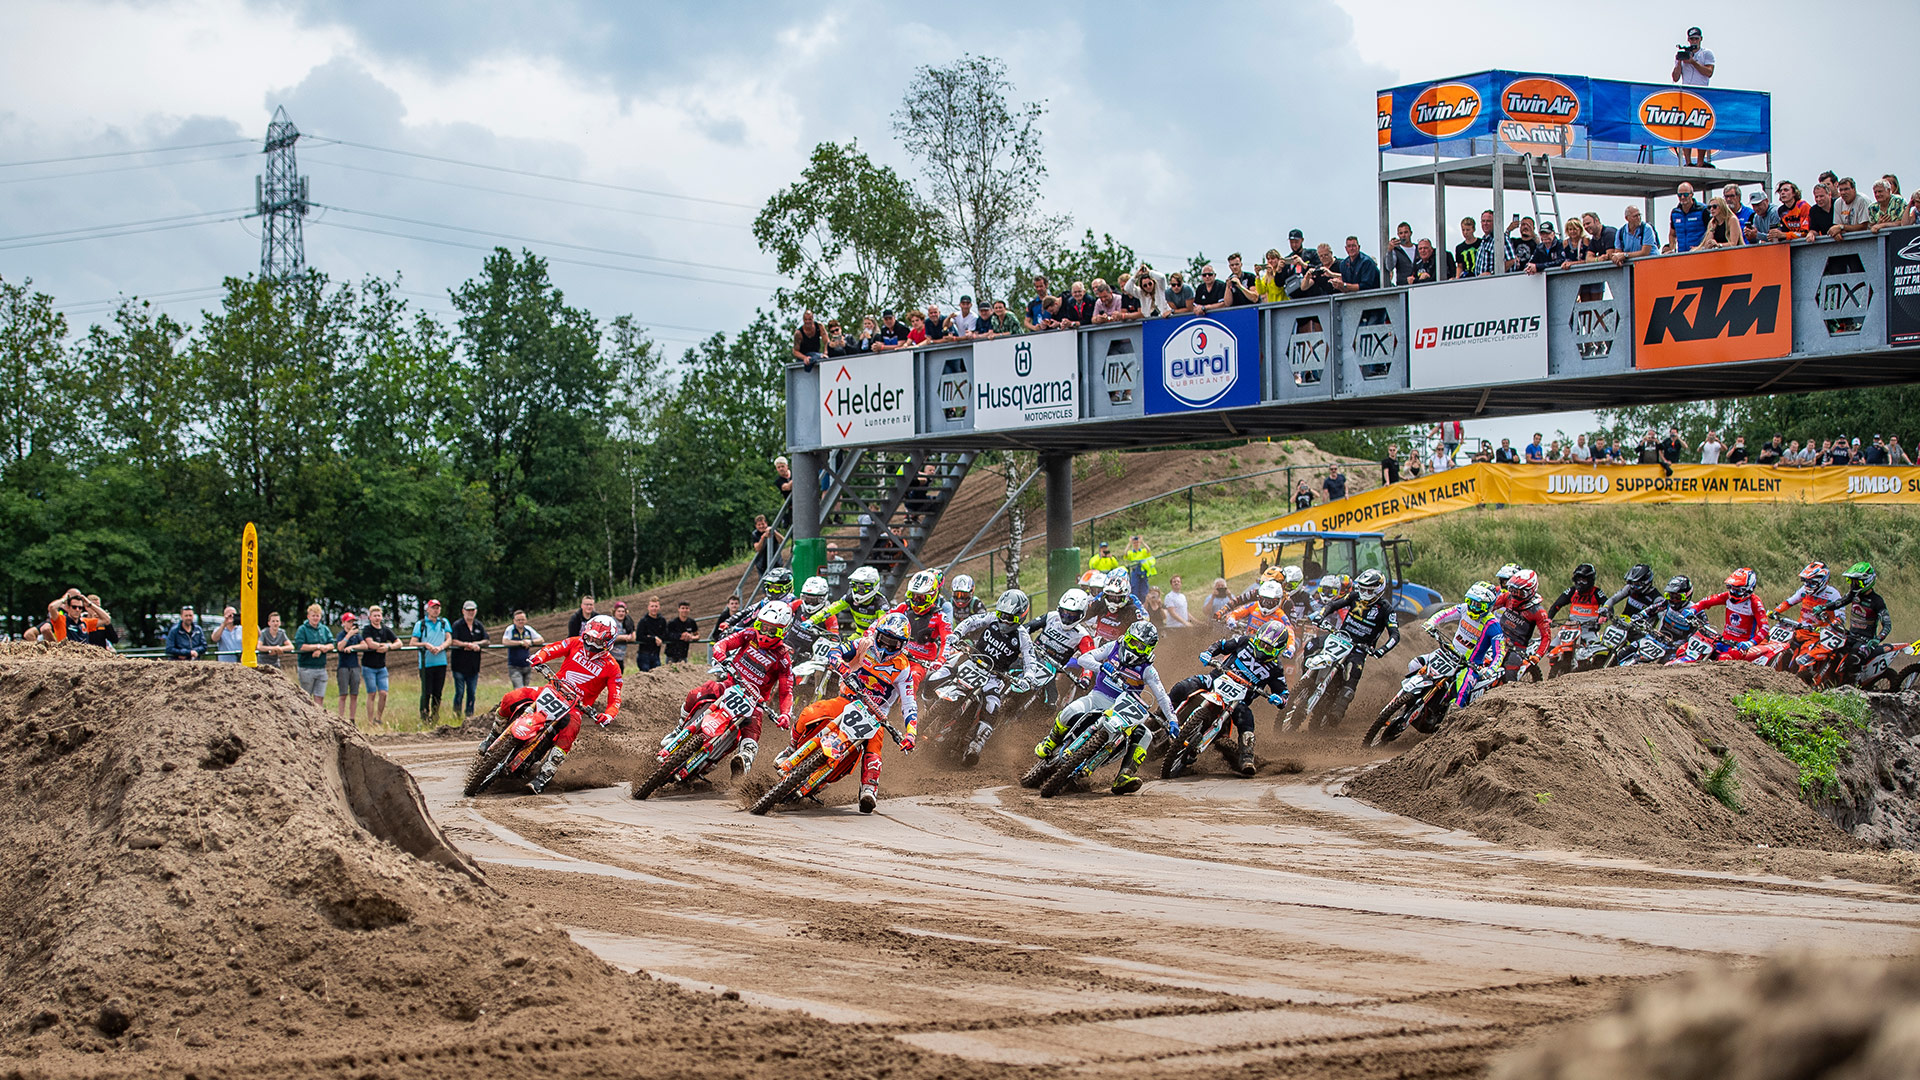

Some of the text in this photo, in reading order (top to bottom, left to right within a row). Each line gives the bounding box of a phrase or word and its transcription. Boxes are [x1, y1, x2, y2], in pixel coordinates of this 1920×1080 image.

[1416, 97, 1478, 123] Twin Air
[1508, 93, 1576, 114] Twin Air
[1646, 106, 1711, 127] Twin Air
[1894, 275, 1911, 286] BUTT
[1643, 273, 1781, 345] KTM
[1442, 315, 1541, 341] HOCOPARTS
[1440, 332, 1539, 347] PREMIUM MOTORCYCLE PRODUCTS
[1171, 347, 1229, 379] eurol
[1170, 376, 1231, 388] LUBRICANTS
[838, 383, 904, 416] Helder
[977, 380, 1072, 411] Husqvarna
[865, 415, 911, 427] Lunteren BV
[1024, 409, 1073, 422] MOTORCYCLES
[1546, 475, 1782, 495] JUMBO SUPPORTER VAN TALENT
[1847, 476, 1902, 494] JUMBO
[1321, 498, 1398, 532] SUPPORTER
[1402, 492, 1427, 510] VAN
[1429, 478, 1476, 503] TALENT
[983, 629, 1014, 657] Quality
[1560, 630, 1578, 641] 181
[1604, 629, 1625, 647] 52
[1769, 627, 1790, 642] 199
[1820, 630, 1843, 648] 73
[746, 645, 772, 667] THOR
[984, 644, 1002, 660] MX
[1325, 640, 1348, 657] 27
[1640, 641, 1663, 658] 228
[1688, 639, 1708, 654] 94
[734, 662, 764, 685] GASGAS
[1237, 648, 1270, 680] FXR
[1429, 654, 1453, 675] 130
[1872, 659, 1888, 674] 73
[958, 665, 987, 688] 826
[1217, 681, 1241, 698] 105
[537, 692, 570, 720] 991
[723, 690, 751, 716] 189
[1113, 699, 1144, 726] 12
[843, 710, 874, 739] 84
